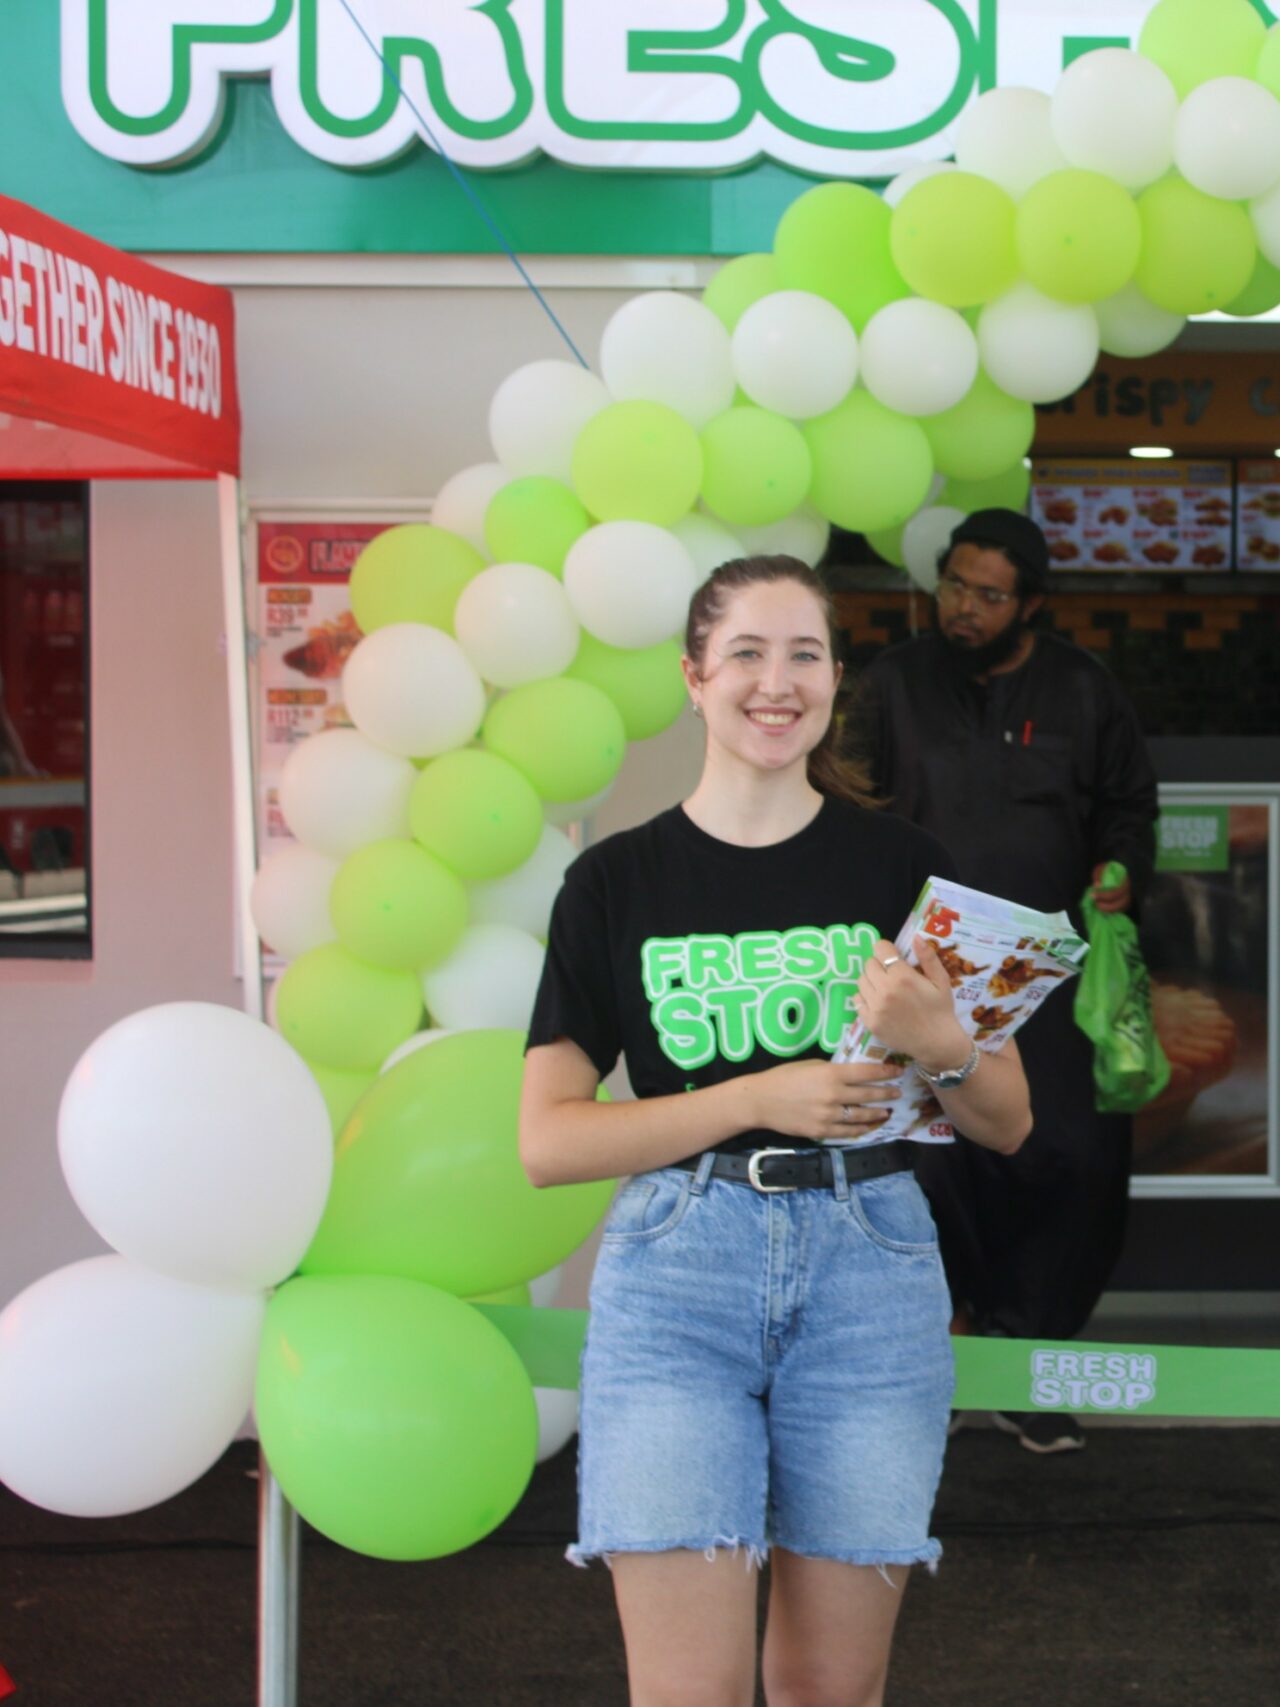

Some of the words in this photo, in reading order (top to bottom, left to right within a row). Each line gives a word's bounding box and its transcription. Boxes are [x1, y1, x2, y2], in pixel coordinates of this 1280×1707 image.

[106, 275, 176, 400] SINCE
[175, 308, 221, 420] 1930
[1037, 372, 1213, 425] rispy
[641, 922, 881, 1002] FRESH
[1031, 1349, 1157, 1381] FRESH
[1031, 1377, 1155, 1410] STOP
